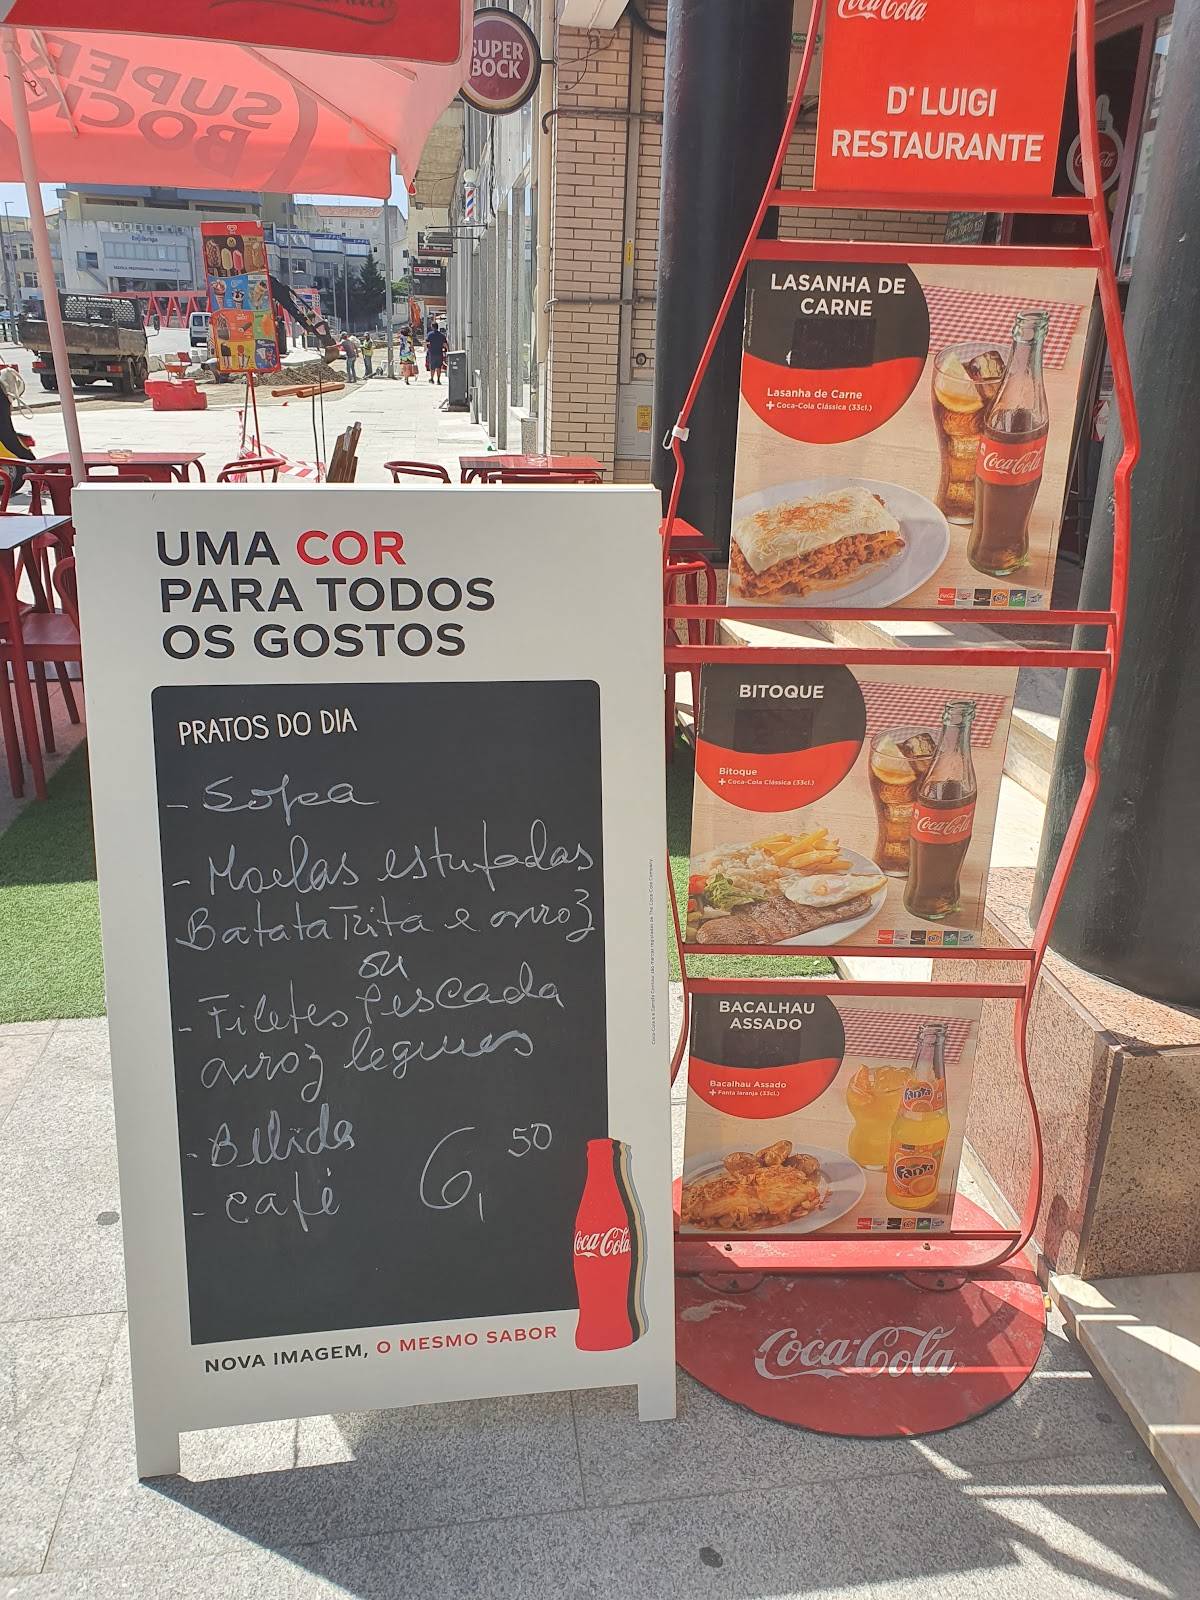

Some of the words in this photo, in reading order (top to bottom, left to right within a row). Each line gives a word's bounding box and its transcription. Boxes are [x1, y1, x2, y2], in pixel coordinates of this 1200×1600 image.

[837, 0, 926, 21] CocaCola
[473, 40, 524, 60] UPER
[471, 58, 521, 79] BOCK
[921, 86, 998, 117] LUIGI
[831, 129, 1046, 162] RESTAURANTE
[771, 273, 871, 293] LASANHA
[878, 277, 906, 294] DE
[800, 298, 873, 316] CARNE
[767, 388, 811, 399] Lasanha
[814, 389, 828, 399] de
[831, 390, 863, 400] Carne
[776, 402, 815, 410] Coca-Cola
[817, 402, 847, 411] Clássica
[156, 530, 281, 567] UMA
[296, 530, 407, 566] COR
[160, 577, 304, 613] PARA
[316, 576, 496, 612] TODOS
[162, 624, 235, 659] OS
[253, 622, 466, 658] GOSTOS
[739, 684, 825, 699] BITOQUE
[178, 714, 270, 746] PRATOS
[277, 711, 312, 738] DO
[320, 708, 358, 735] DIA
[719, 767, 758, 778] Bitoque
[175, 898, 333, 952] Batata
[445, 911, 481, 933] e
[358, 950, 409, 980] ou
[719, 1001, 815, 1015] BACALHAU
[730, 1018, 802, 1031] ASSADO
[710, 1080, 751, 1088] Bacalhau
[574, 1227, 631, 1258] Coca-Cola
[204, 1354, 266, 1374] NOVA
[273, 1344, 369, 1366] IMAGEM,
[376, 1341, 392, 1354] O
[400, 1332, 478, 1352] MESMO
[486, 1325, 557, 1344] SABOR
[755, 1326, 956, 1380] Coca-Cola
